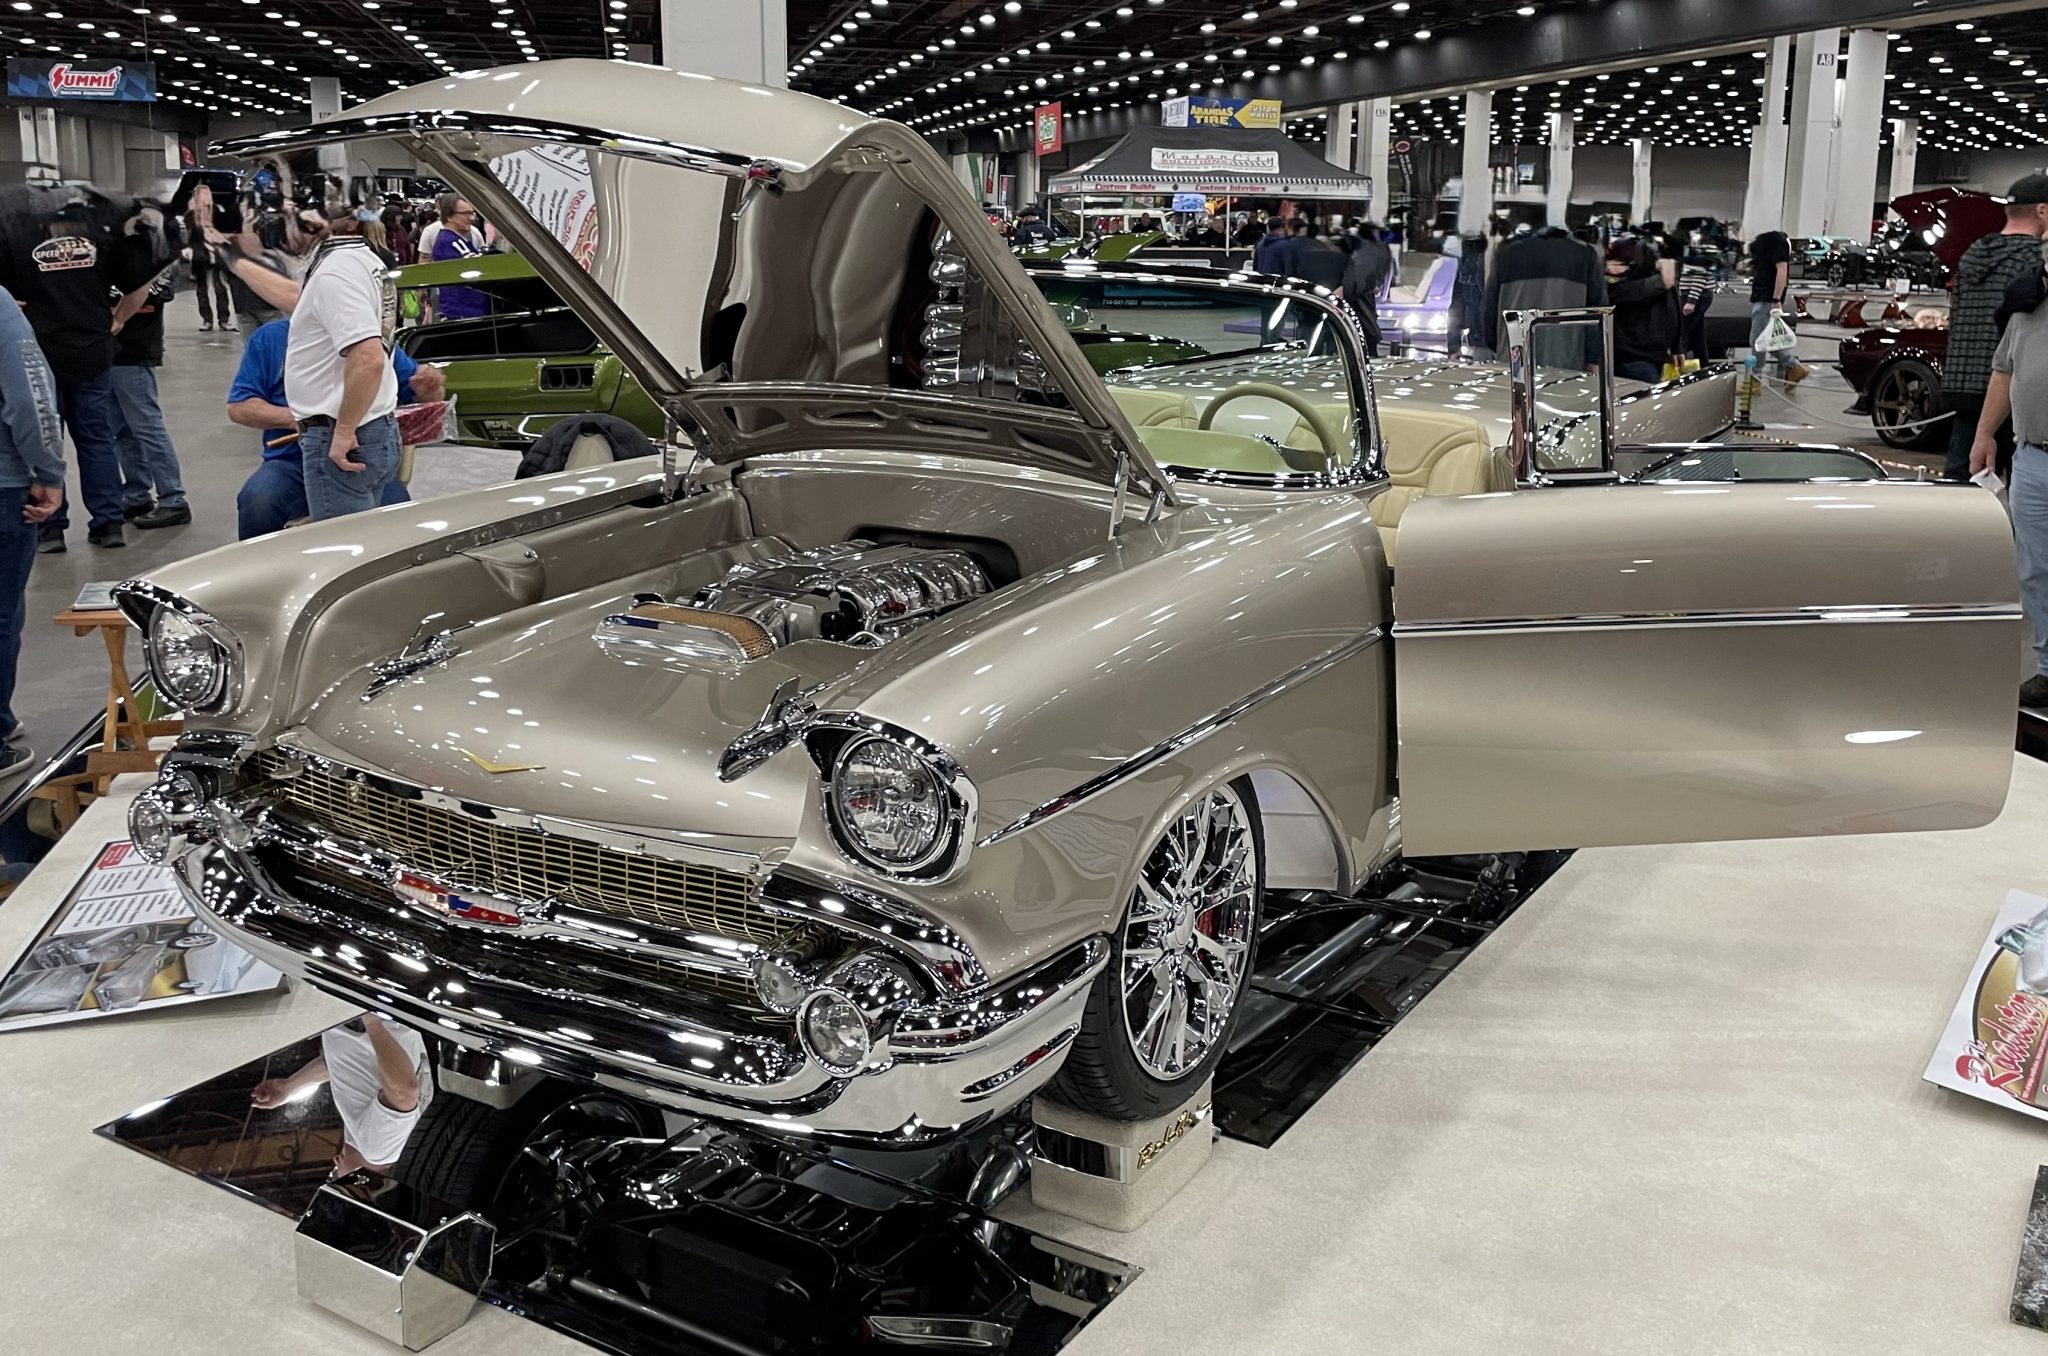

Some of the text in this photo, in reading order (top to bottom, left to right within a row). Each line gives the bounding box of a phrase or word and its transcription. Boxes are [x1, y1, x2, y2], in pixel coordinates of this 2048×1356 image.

[1819, 54, 1833, 66] A8
[1190, 105, 1234, 116] ARANDAS
[1194, 115, 1230, 126] TIRE
[1094, 183, 1157, 191] Custom Builds
[1194, 184, 1267, 193] Custom Interiors
